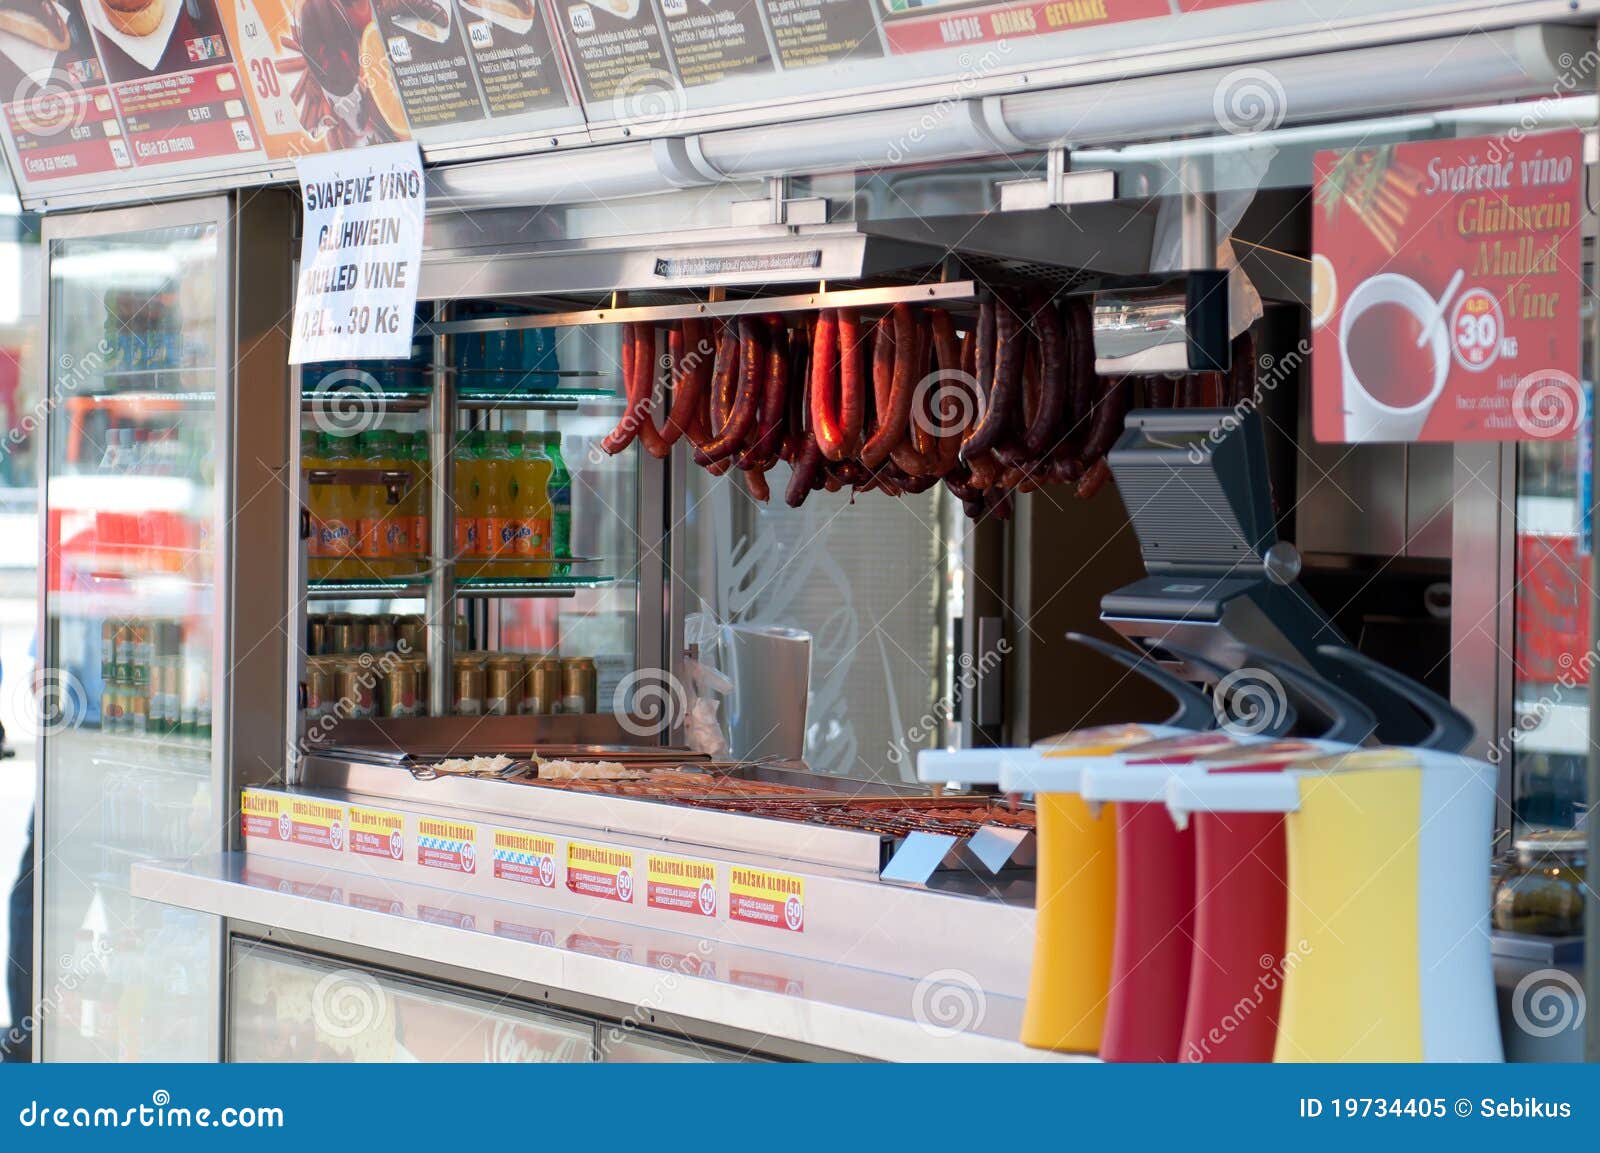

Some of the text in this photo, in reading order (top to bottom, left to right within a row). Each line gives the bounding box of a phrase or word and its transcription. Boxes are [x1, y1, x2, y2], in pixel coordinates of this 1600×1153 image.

[573, 16, 584, 28] 40
[991, 8, 1037, 36] DRINKS
[472, 28, 482, 41] 40
[251, 57, 280, 98] 30
[135, 136, 194, 156] Cena za menu
[25, 156, 44, 173] Cena
[1425, 150, 1573, 195] Svařené víno
[305, 164, 420, 211] SVAŘENÉ VÍNO
[1457, 193, 1571, 236] Glühwein
[1472, 236, 1560, 277] Mulled
[305, 261, 408, 296] MULLED VINE
[348, 306, 369, 335] 30
[375, 305, 400, 334] Kč
[1458, 314, 1496, 347] 30
[280, 816, 288, 829] 35
[391, 836, 400, 848] 40
[463, 846, 472, 858] 40
[542, 860, 552, 874] 40
[684, 862, 713, 882] KLOBÁSA
[620, 874, 629, 889] 50
[732, 867, 800, 895] PRAŽSKÁ KLOBÁSA
[701, 889, 712, 904] 40
[788, 903, 799, 918] 50
